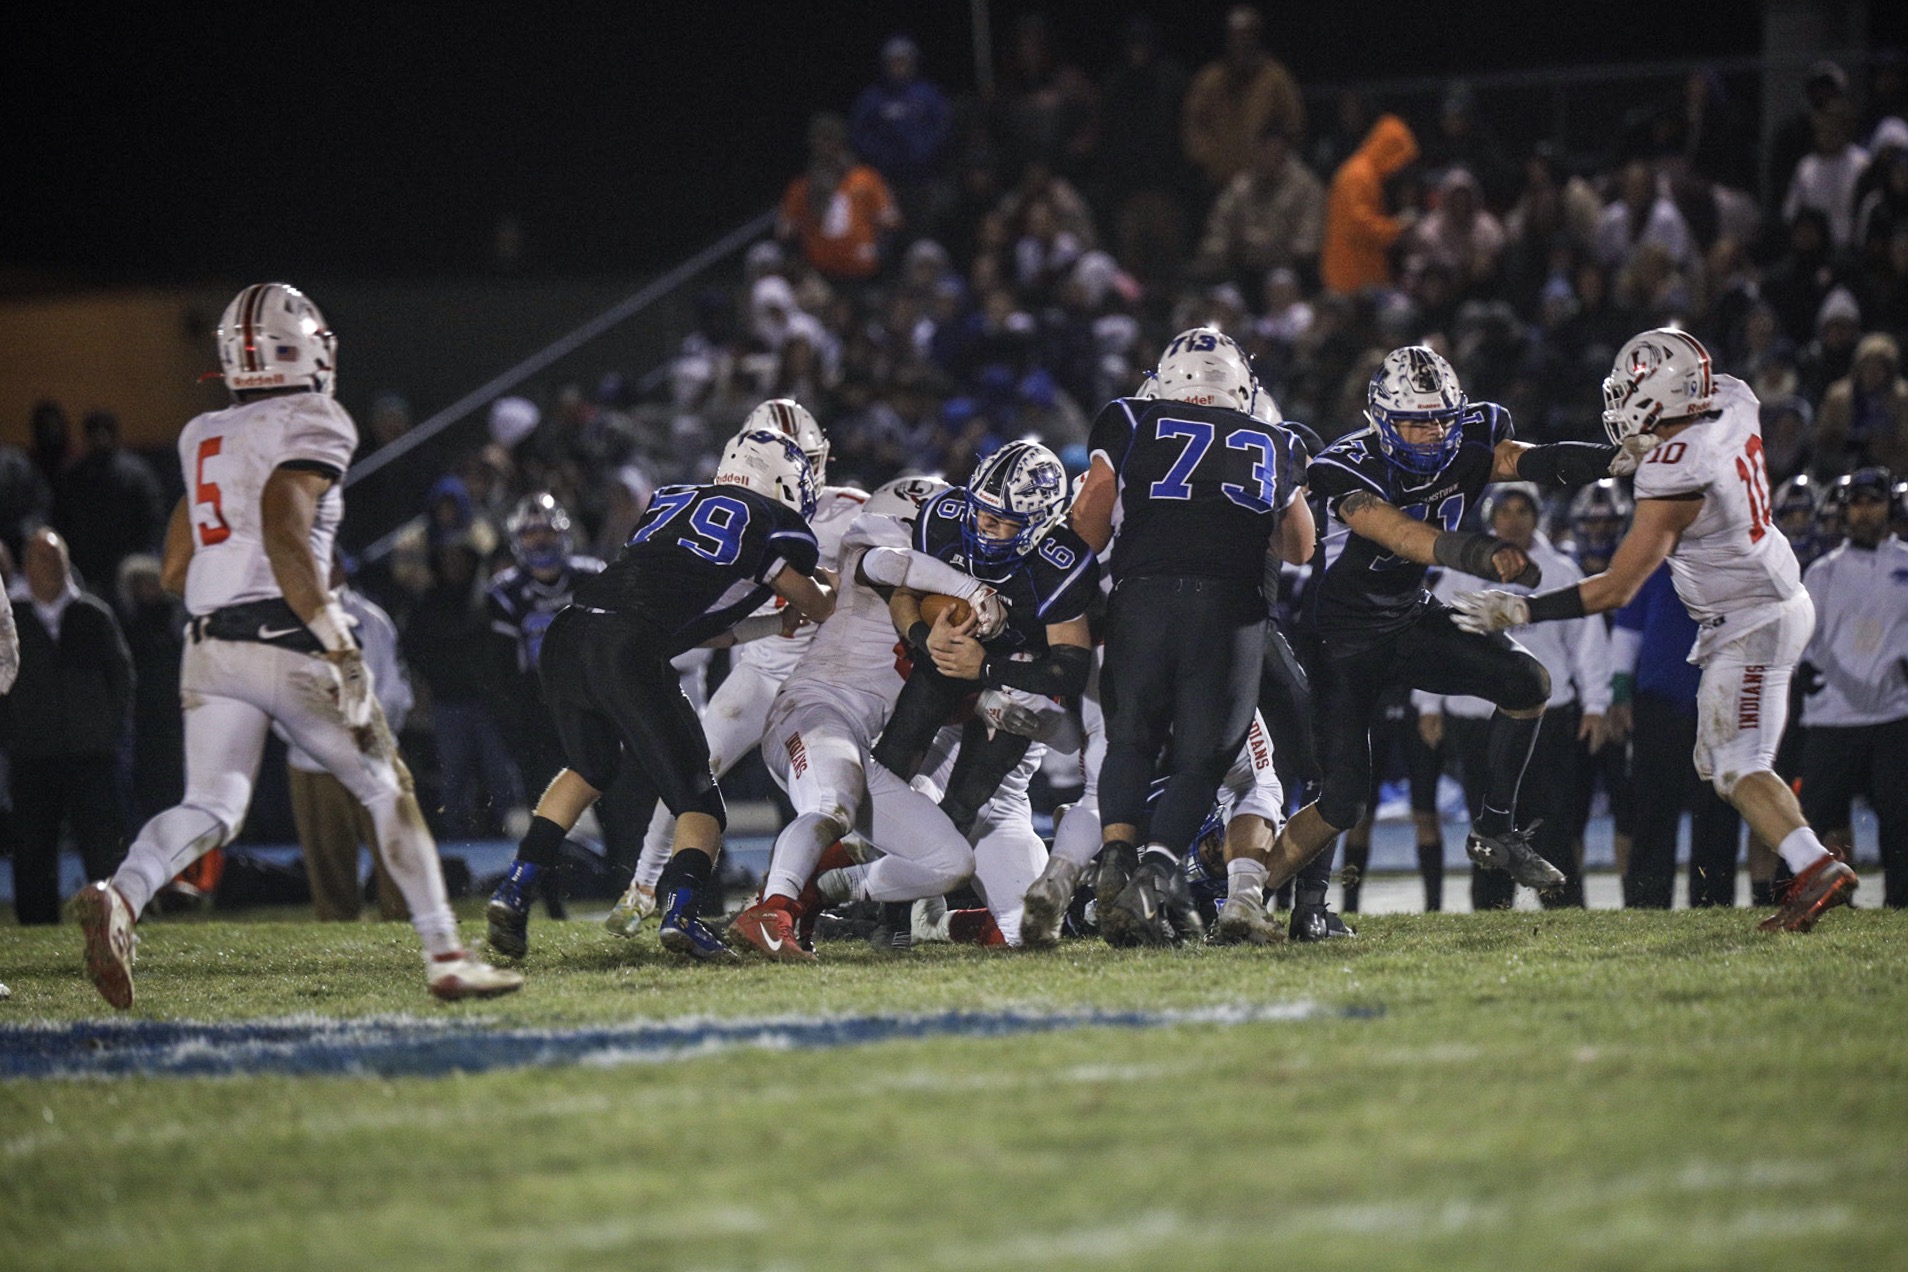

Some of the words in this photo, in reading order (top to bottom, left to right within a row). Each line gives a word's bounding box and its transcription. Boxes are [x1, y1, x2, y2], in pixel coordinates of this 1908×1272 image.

[1149, 417, 1278, 515] 73
[1645, 442, 1688, 464] 10
[195, 436, 232, 547] 5
[1736, 433, 1774, 544] 10
[624, 490, 751, 566] 79
[1038, 537, 1076, 570] 6
[1739, 665, 1766, 730] INDIANS
[784, 731, 808, 780] INDIANS
